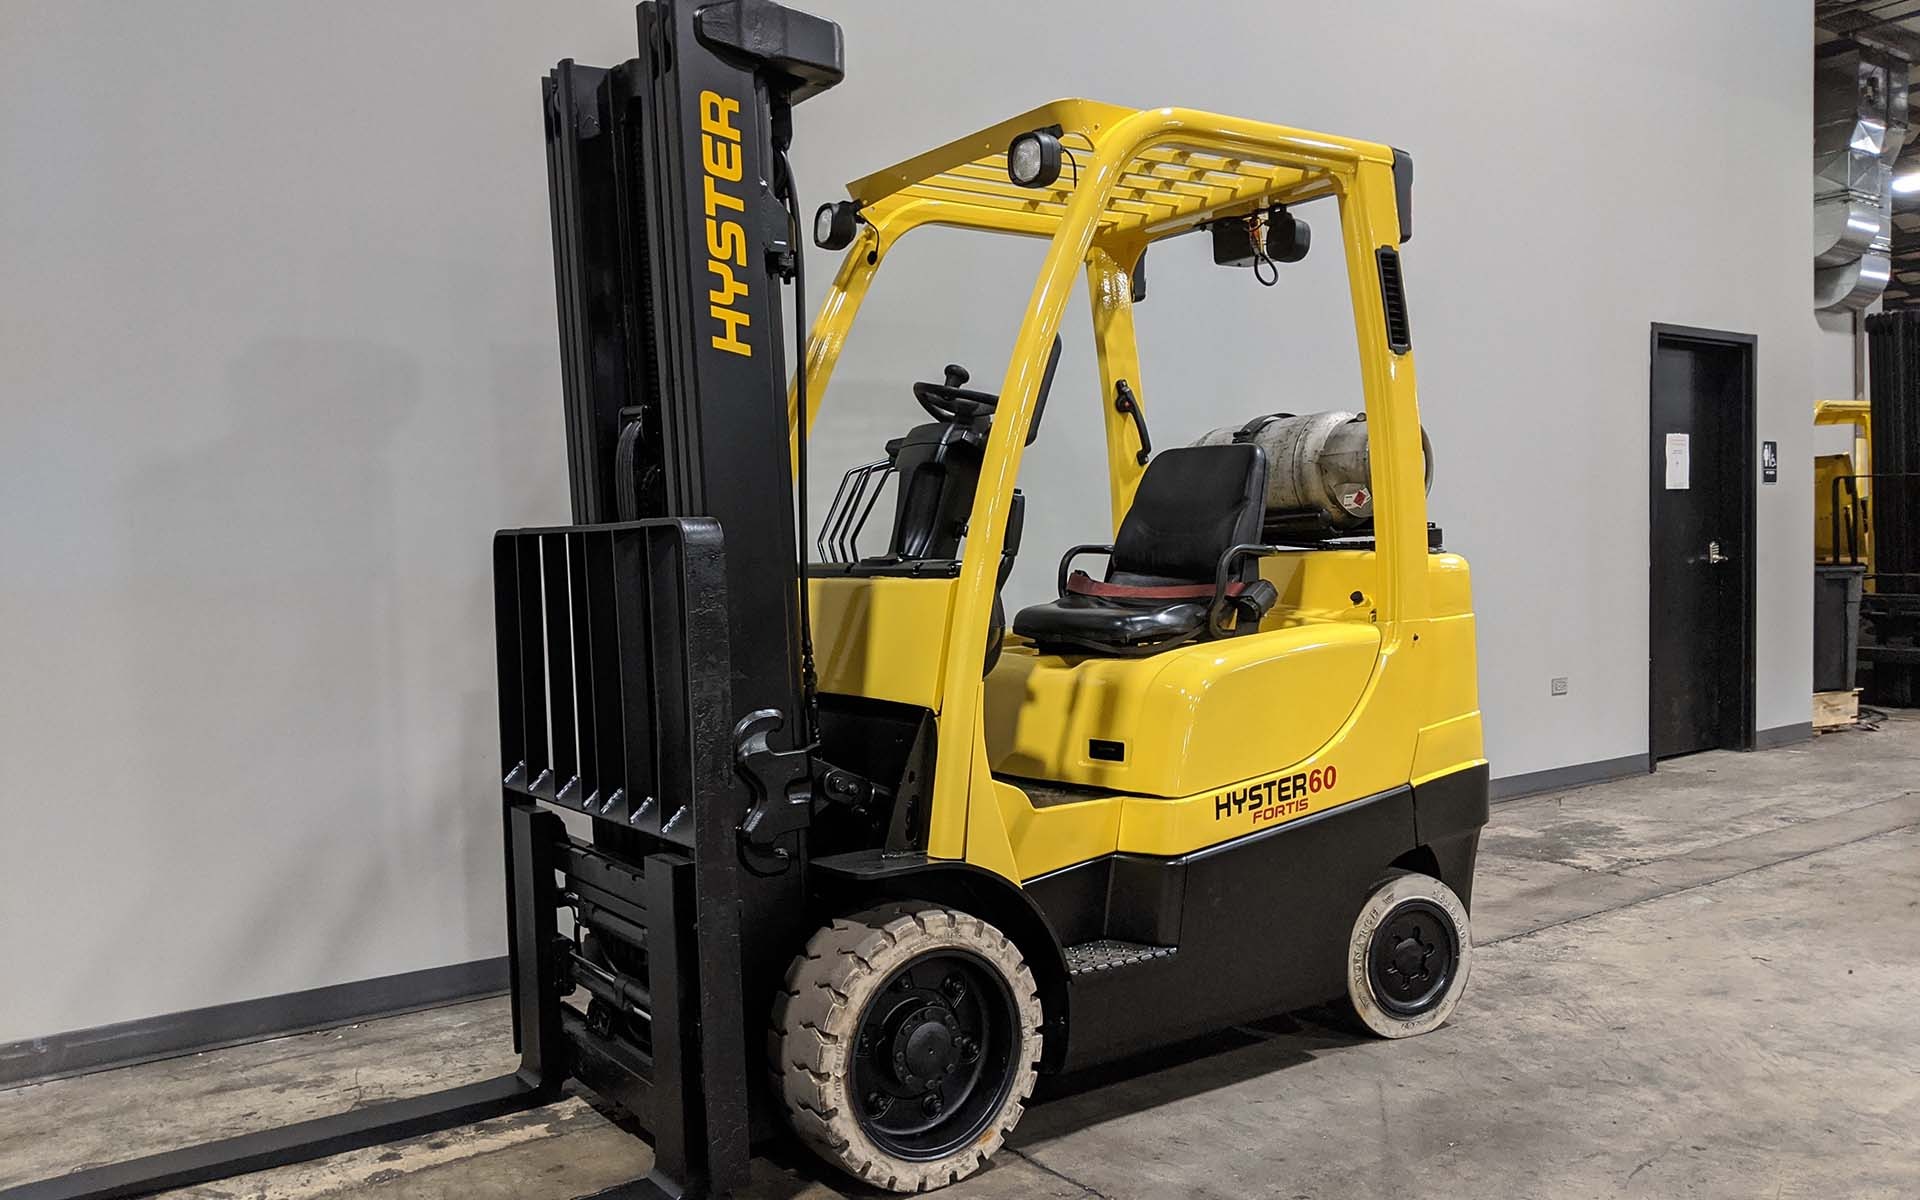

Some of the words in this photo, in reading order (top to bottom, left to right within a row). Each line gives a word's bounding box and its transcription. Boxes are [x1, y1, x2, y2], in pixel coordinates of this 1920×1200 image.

[700, 90, 752, 357] HYSTER
[1215, 772, 1307, 821] HYSTER
[1309, 765, 1337, 793] 60
[1252, 798, 1309, 825] FORTIS
